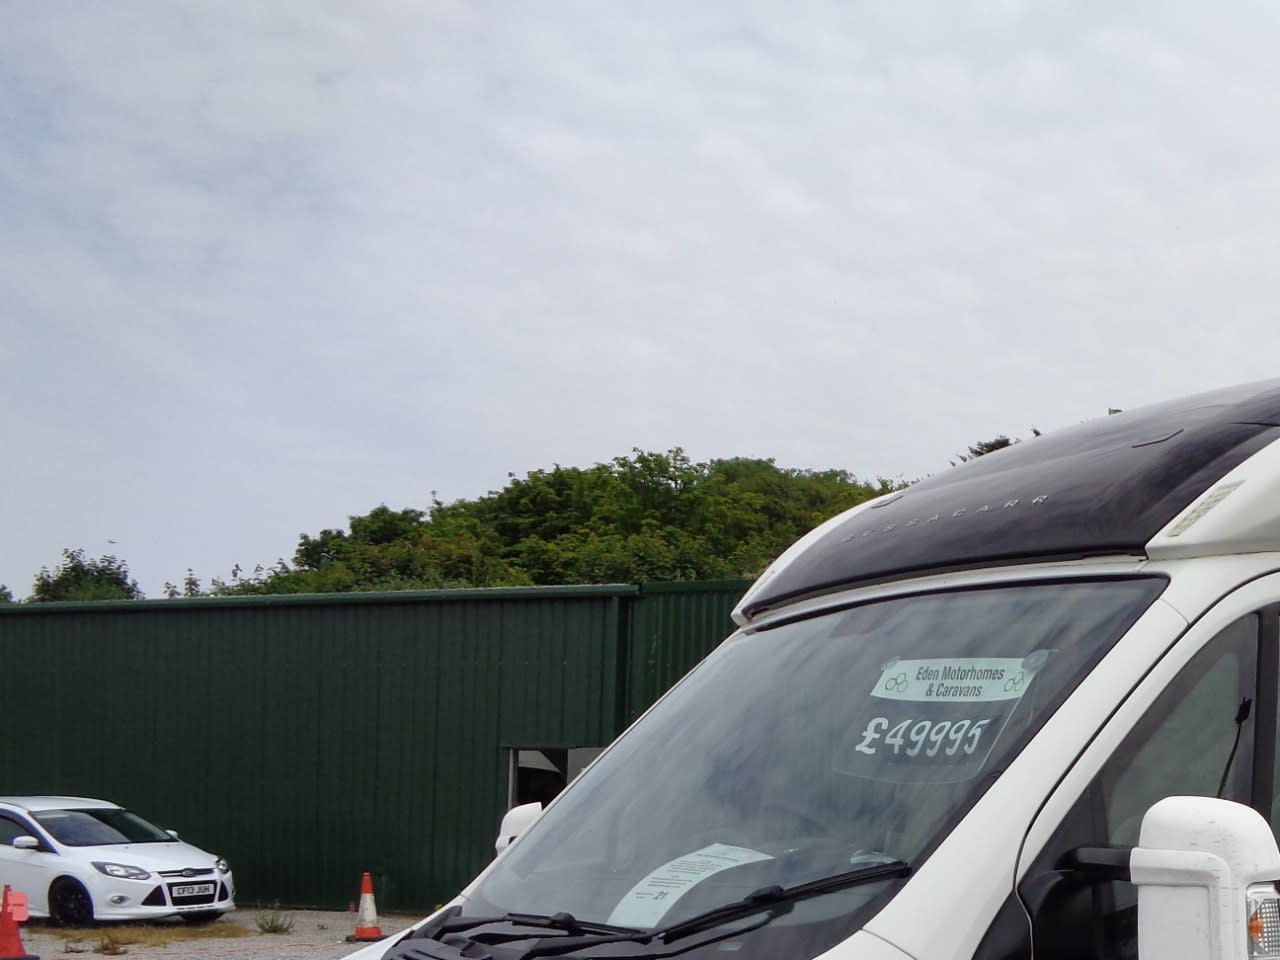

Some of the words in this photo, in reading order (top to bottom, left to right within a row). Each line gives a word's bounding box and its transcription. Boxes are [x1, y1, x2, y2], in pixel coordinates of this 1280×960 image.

[916, 666, 940, 680] Eden
[942, 665, 1005, 681] Motorhomes
[925, 684, 935, 697] &
[936, 683, 983, 698] Caravans
[855, 717, 990, 757] £49995
